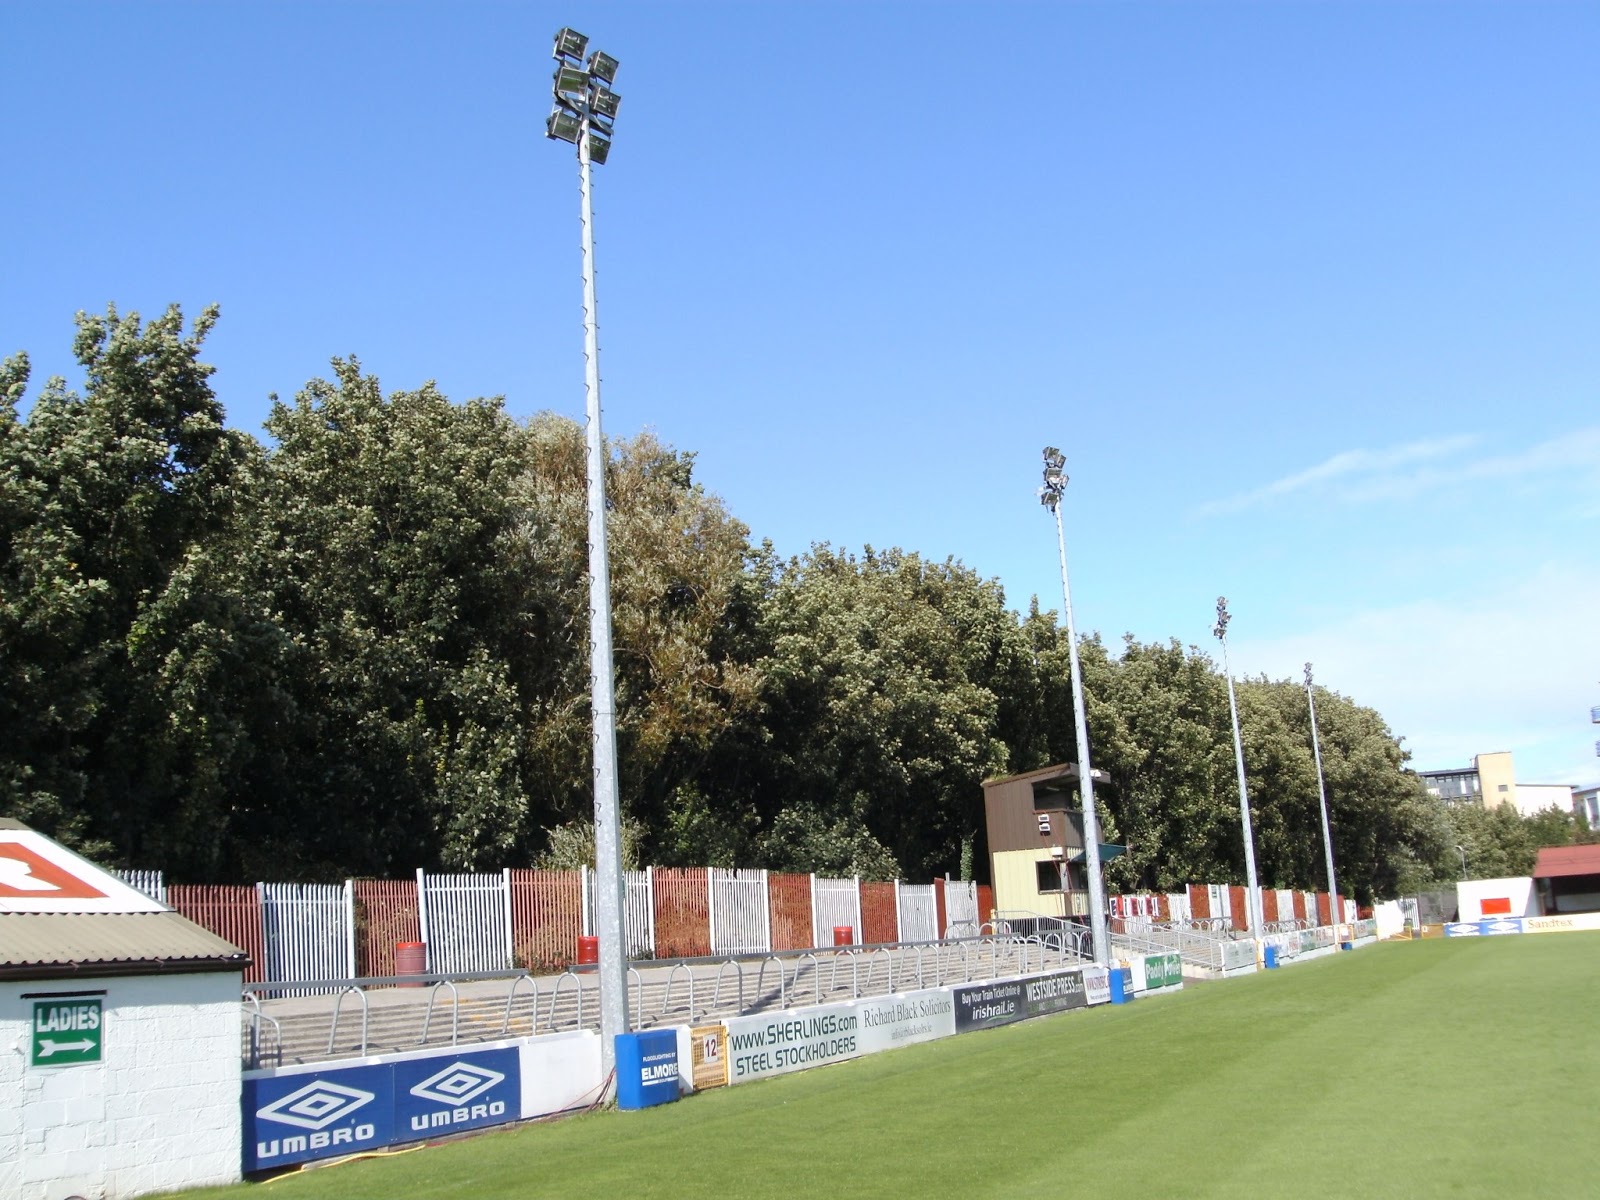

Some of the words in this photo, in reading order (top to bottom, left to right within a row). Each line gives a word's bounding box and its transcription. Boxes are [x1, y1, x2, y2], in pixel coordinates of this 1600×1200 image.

[1528, 918, 1573, 929] Sandtex
[1146, 961, 1163, 980] Paddy
[961, 993, 971, 1006] Buy
[971, 990, 982, 1001] Your
[982, 989, 993, 1001] Train
[993, 987, 1005, 999] Ticket
[1005, 986, 1017, 997] Online
[1026, 978, 1057, 1002] WESTSIDE
[36, 1005, 99, 1033] LADIES
[863, 1005, 896, 1027] Richard
[896, 1002, 918, 1021] Black
[919, 998, 951, 1017] Solicitors
[972, 1000, 1014, 1020] irishrail.ie
[731, 1014, 858, 1051] www.SHERLINGS.com
[705, 1038, 717, 1058] 12
[736, 1052, 773, 1076] STEEL
[775, 1035, 856, 1068] STOCKHOLDERS
[641, 1062, 679, 1081] ELMORE
[411, 1101, 505, 1131] UMBRO
[257, 1123, 375, 1159] UMBRO
